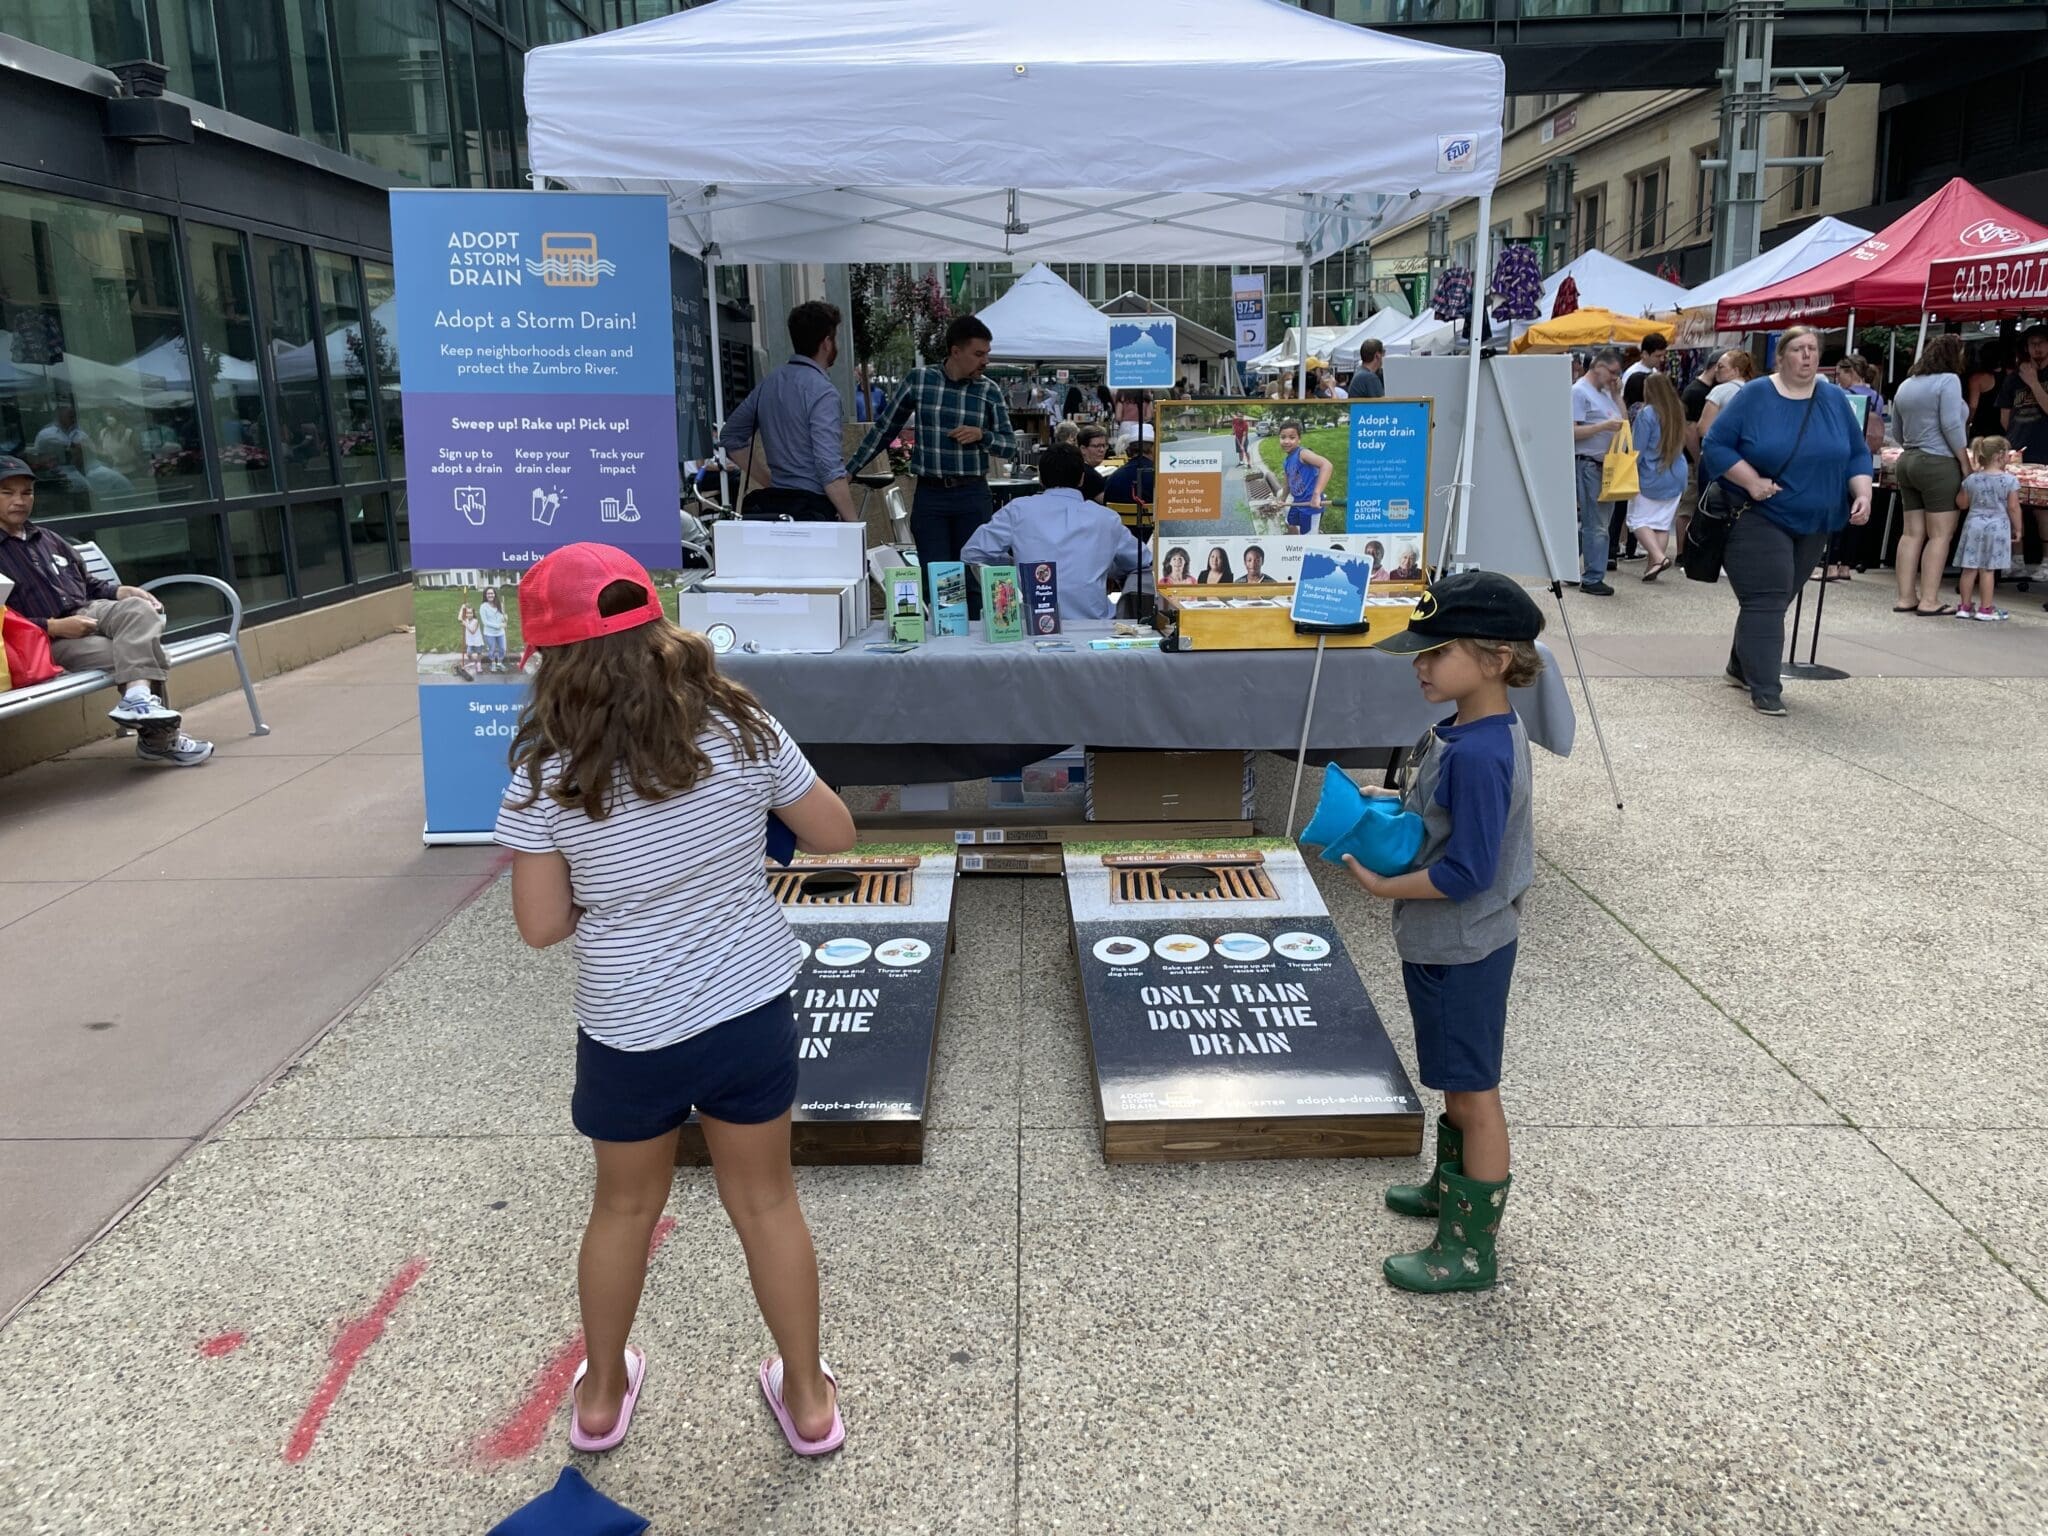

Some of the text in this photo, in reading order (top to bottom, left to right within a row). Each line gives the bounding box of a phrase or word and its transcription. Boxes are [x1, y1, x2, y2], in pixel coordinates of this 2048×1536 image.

[448, 232, 520, 249] ADOPT
[450, 252, 520, 266] A STORM
[450, 269, 522, 286] DRAIN
[1236, 301, 1256, 314] 97.5
[434, 310, 638, 332] Adopt a Storm Drain!
[440, 343, 634, 360] Keep neighborhoods clean and
[458, 362, 618, 377] protect the Zumbro River.
[451, 417, 630, 433] Sweep up! Rake up! Pick up!
[1358, 415, 1389, 427] Adopt
[1358, 427, 1415, 437] storm drain
[1357, 440, 1386, 451] today
[438, 448, 493, 461] Sign up to
[515, 448, 570, 461] Keep your
[590, 448, 645, 461] Track your
[515, 463, 571, 474] drain clear
[1178, 458, 1218, 466] ROCHESTER
[431, 463, 503, 476] adopt a drain
[599, 463, 636, 476] impact
[1191, 496, 1202, 504] the
[503, 551, 545, 563] Lead by
[1302, 591, 1342, 602] Zumbro River
[1314, 585, 1336, 595] protect
[468, 701, 492, 714] Sign
[495, 704, 509, 714] up
[803, 989, 880, 1008] RAIN
[1140, 982, 1310, 1005] ONLY RAIN
[809, 1011, 874, 1033] THE
[1148, 1005, 1317, 1031] DOWN THE
[1189, 1031, 1292, 1056] DRAIN
[801, 1099, 912, 1112] adopt-a-drain.org
[1296, 1092, 1408, 1107] adopt-a-drain.org
